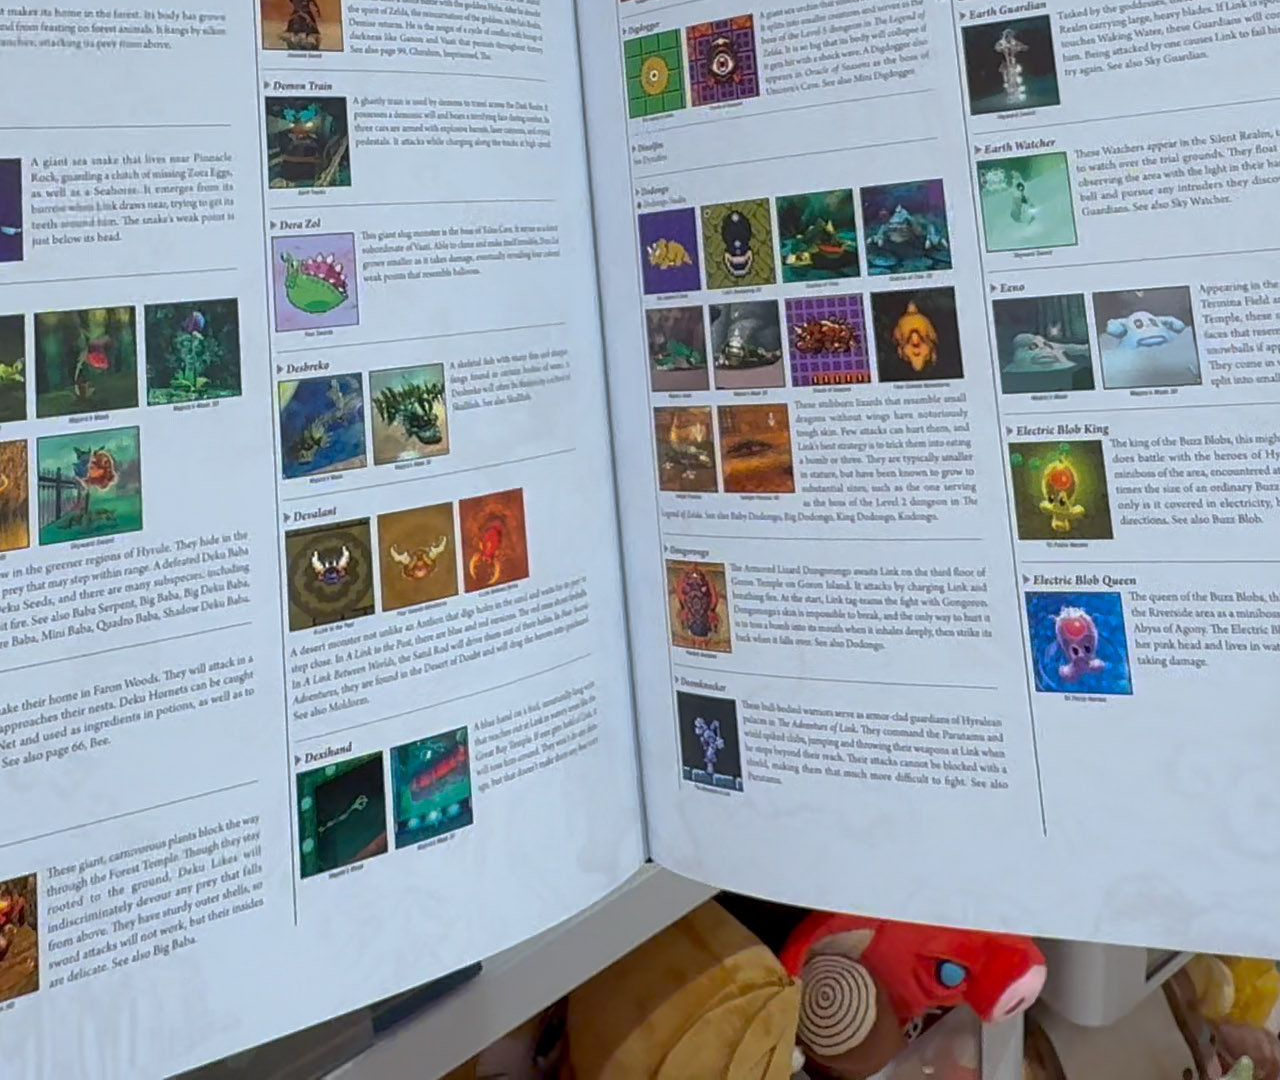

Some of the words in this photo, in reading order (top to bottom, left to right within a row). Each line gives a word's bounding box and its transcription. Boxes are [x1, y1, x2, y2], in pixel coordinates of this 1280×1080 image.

[969, 6, 996, 19] Earth
[998, 1, 1046, 14] Guardian
[272, 80, 305, 90] Demon
[308, 81, 332, 90] Train
[983, 142, 1012, 154] Earth
[1014, 138, 1055, 150] Watcher
[1132, 202, 1148, 211] See
[1150, 199, 1169, 209] also
[1170, 197, 1187, 208] Sky
[279, 220, 302, 230] Dera
[304, 217, 320, 228] Zol
[1016, 425, 1054, 435] Electric
[1057, 423, 1081, 434] Blob
[1084, 423, 1109, 436] King
[12, 569, 22, 578] in
[25, 563, 42, 575] the
[45, 559, 82, 575] greener
[85, 552, 121, 567] regions
[123, 547, 134, 559] of
[174, 539, 197, 550] They
[199, 534, 219, 546] hide
[233, 530, 247, 540] the
[1033, 574, 1071, 585] Electric
[1074, 574, 1099, 585] Blob
[1101, 574, 1136, 587] Queen
[31, 615, 48, 625] See
[50, 610, 70, 622] also
[72, 605, 96, 618] Baba
[139, 595, 155, 607] Big
[183, 587, 199, 599] Big
[200, 582, 224, 595] Deku
[1127, 590, 1147, 601] The
[1148, 593, 1178, 604] queen
[1179, 592, 1190, 601] of
[1191, 592, 1207, 601] the
[1209, 592, 1234, 601] Buzz
[1136, 654, 1168, 668] taking
[21, 698, 46, 710] their
[48, 692, 78, 705] home
[80, 689, 90, 698] in
[93, 683, 122, 695] Faron
[162, 669, 186, 680] They
[188, 662, 206, 674] will
[208, 656, 235, 671] attack
[236, 657, 245, 665] in
[248, 655, 253, 663] a
[1, 756, 19, 768] See
[22, 751, 43, 763] also
[45, 746, 69, 761] page
[304, 741, 352, 763] Dexihand
[48, 976, 64, 988] are
[111, 956, 128, 968] See
[131, 950, 150, 962] also
[153, 944, 169, 956] Big
